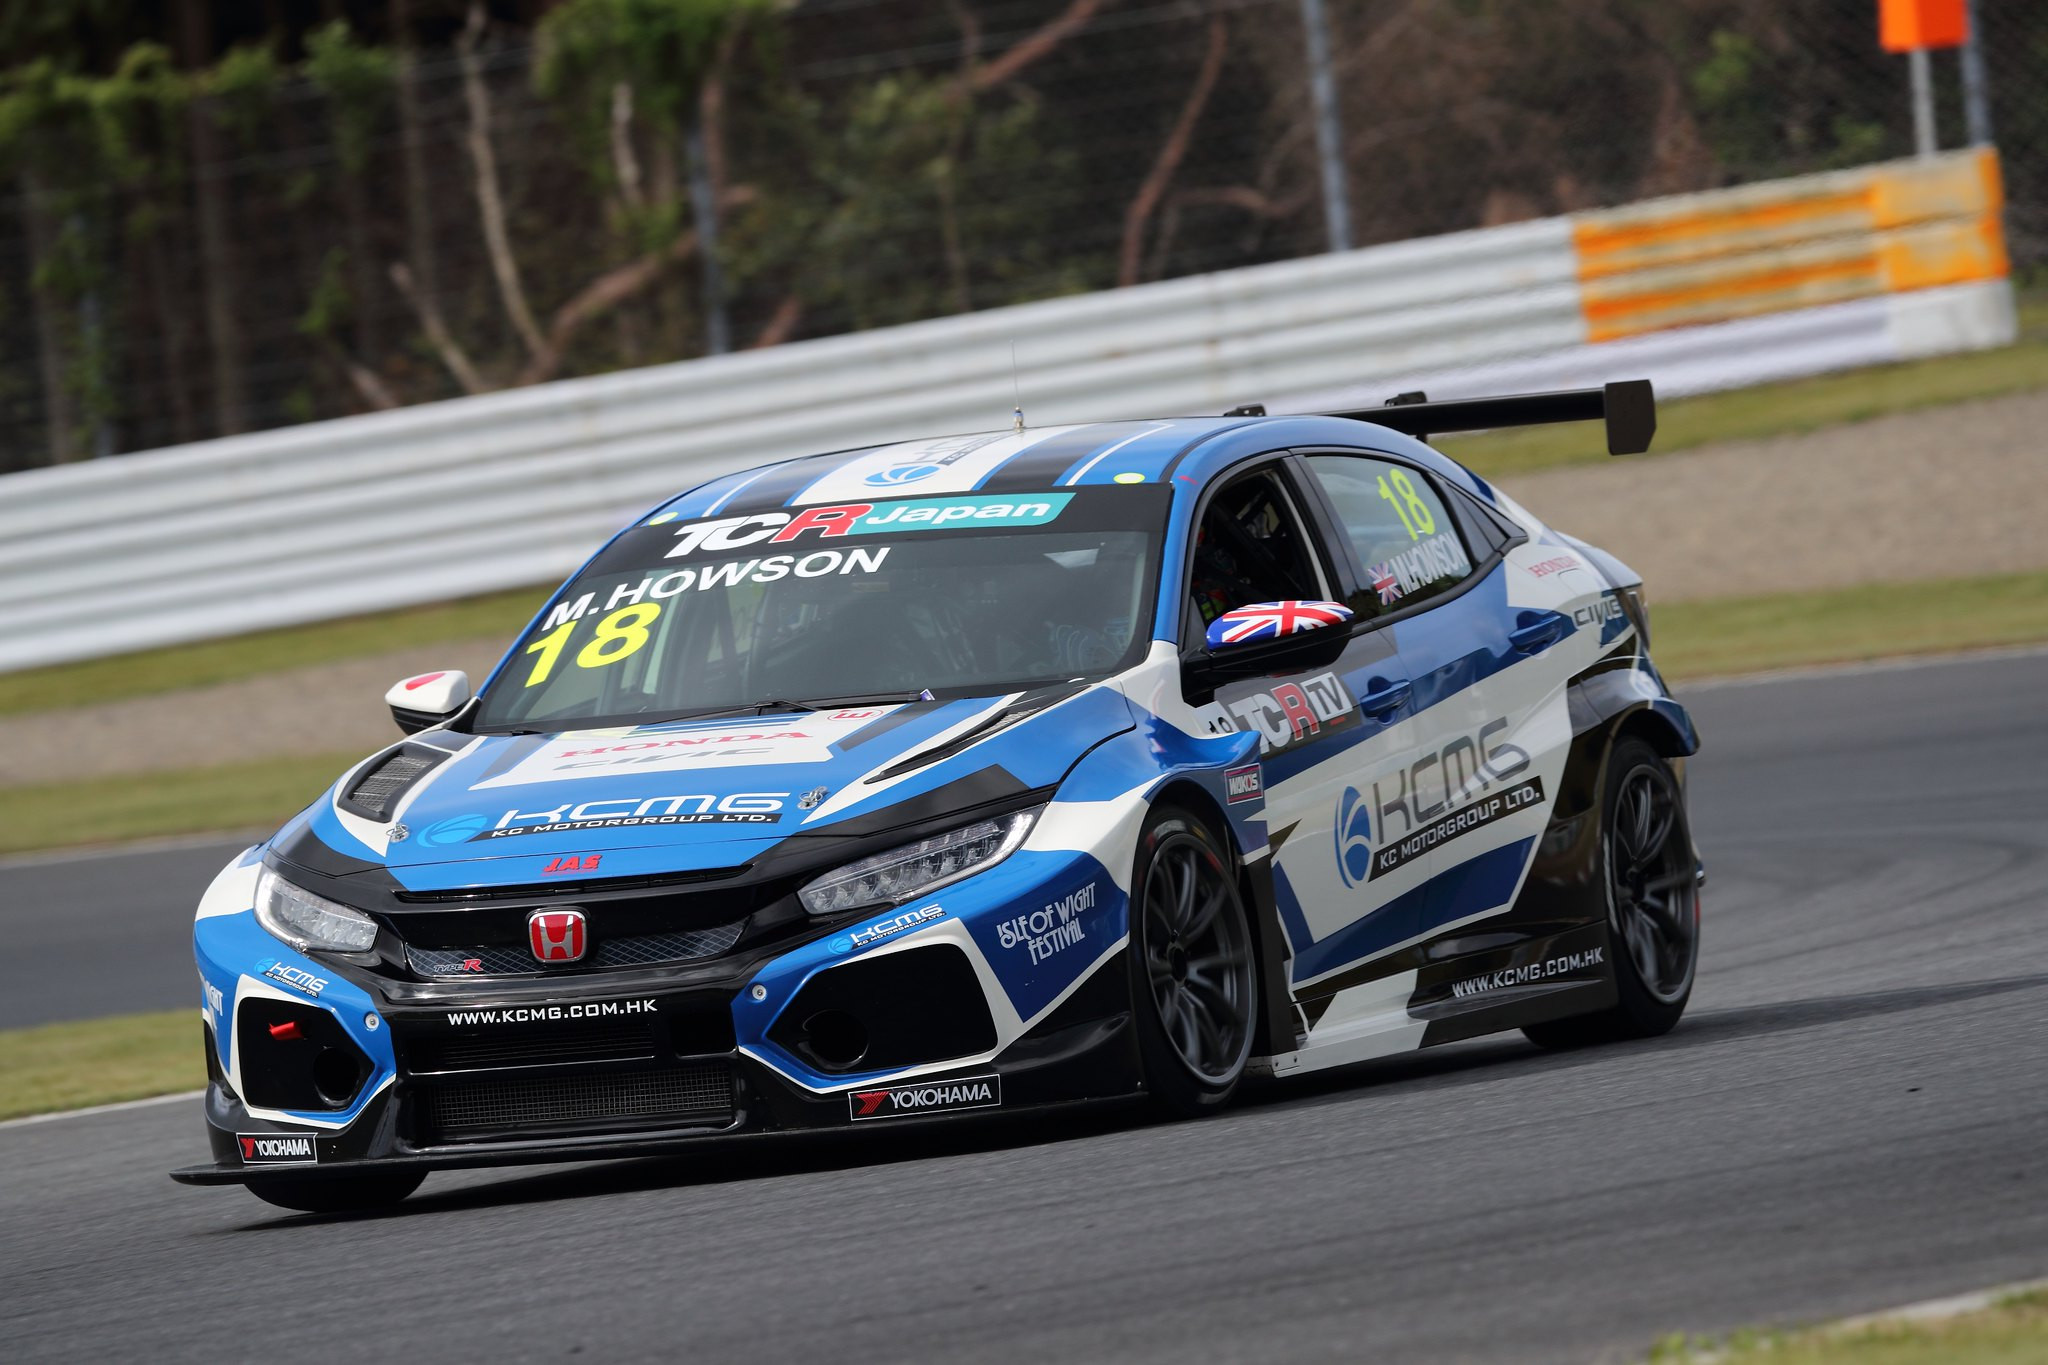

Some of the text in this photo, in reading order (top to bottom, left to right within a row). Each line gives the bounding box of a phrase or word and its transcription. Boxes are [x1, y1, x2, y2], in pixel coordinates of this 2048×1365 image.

[1376, 468, 1435, 541] 18
[664, 501, 1050, 558] TCR Japan
[542, 546, 891, 631] M.HOWSON
[525, 602, 662, 687] 18
[1228, 676, 1345, 754] TCR TV
[553, 747, 774, 770] CIVIC
[556, 732, 814, 759] HONDA
[1373, 716, 1530, 845] KCMG
[492, 814, 772, 838] KC MOTORGROUP LTD.
[495, 792, 790, 829] KCMG
[1379, 786, 1540, 870] KC MOTORGROUP LTD.
[543, 854, 603, 872] JAS
[850, 903, 943, 943] KCMG
[996, 881, 1096, 949] ISLE OF WIGHT
[1027, 917, 1086, 966] FESTIVAL
[269, 962, 329, 992] KCMG
[1451, 946, 1604, 998] WWW.KCMG.COM.HK
[448, 999, 658, 1026] WWW.KCMG.COM.HK
[888, 1083, 992, 1110] YOKOHAMA
[254, 1138, 312, 1157] YOKOHAMA
